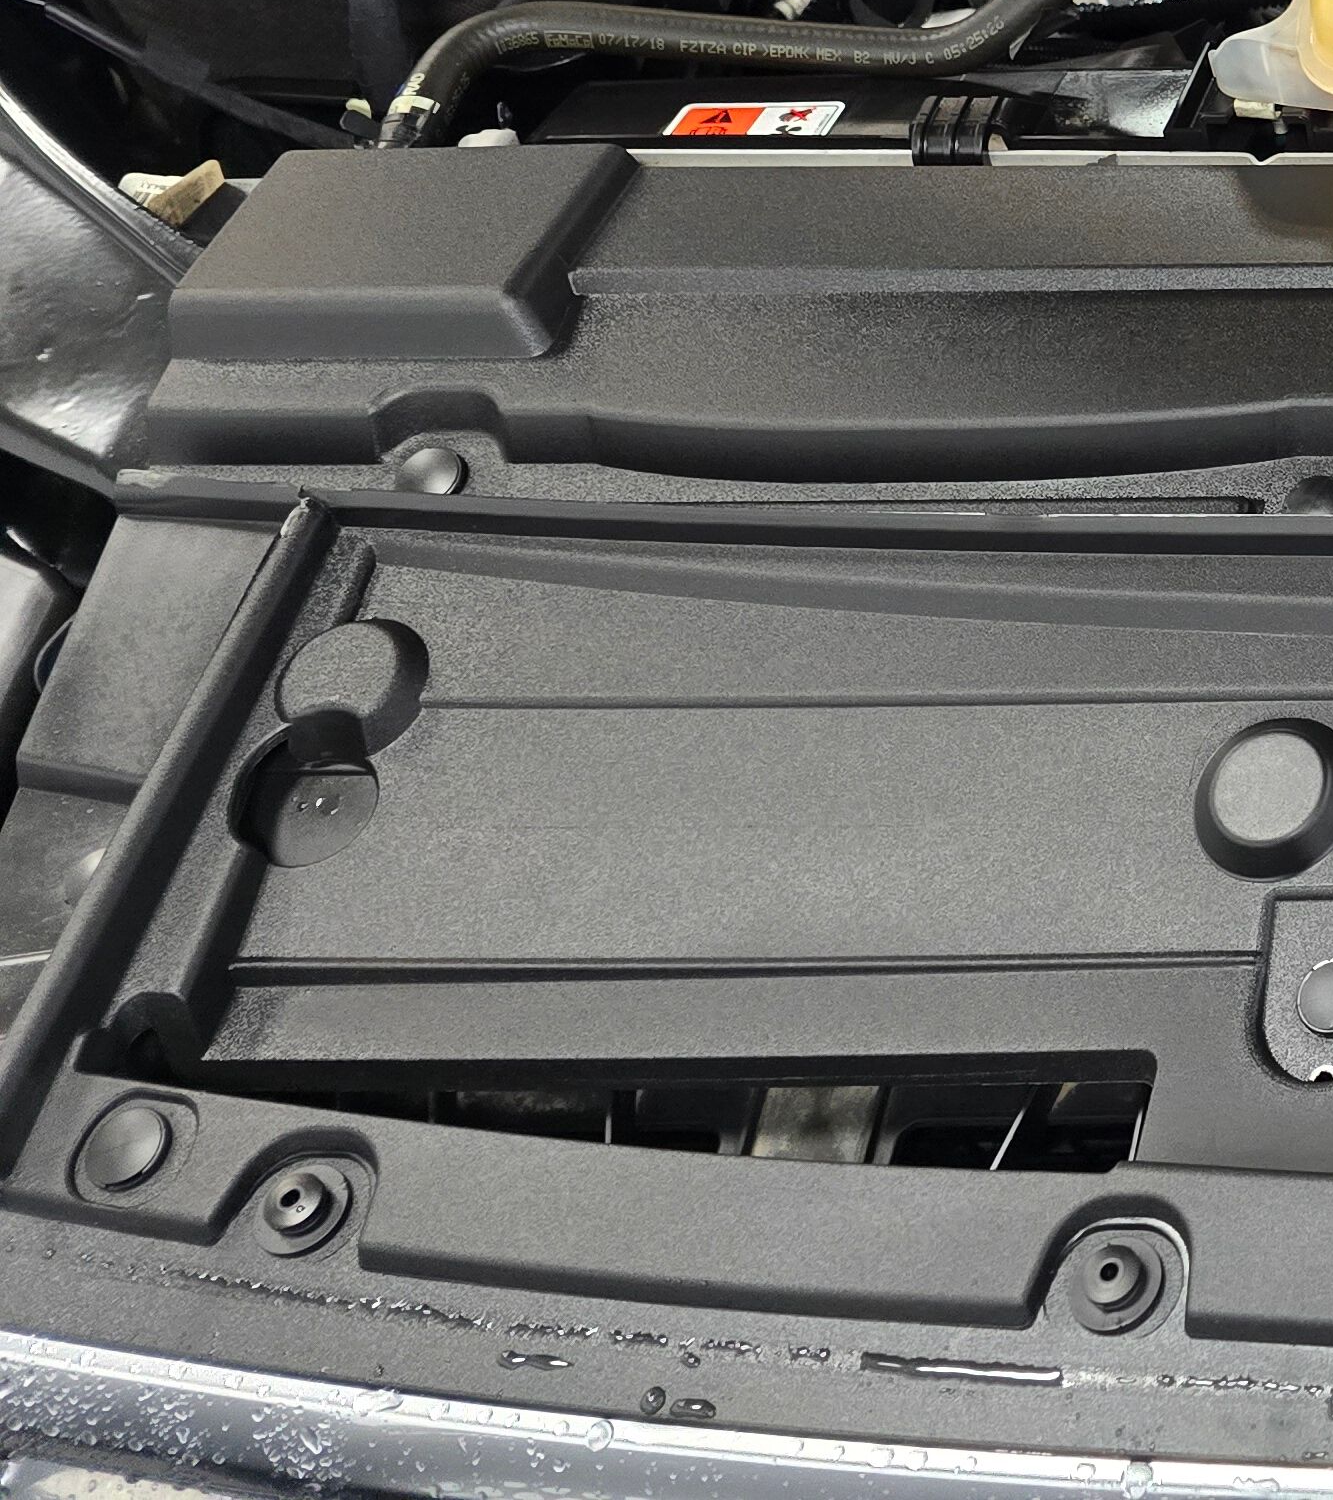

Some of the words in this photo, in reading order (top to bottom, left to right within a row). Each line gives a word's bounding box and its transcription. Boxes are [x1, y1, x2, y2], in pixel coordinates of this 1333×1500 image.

[599, 32, 665, 51] 07/17/18
[732, 41, 757, 56] CIP
[854, 50, 871, 64] B2
[925, 52, 935, 65] C
